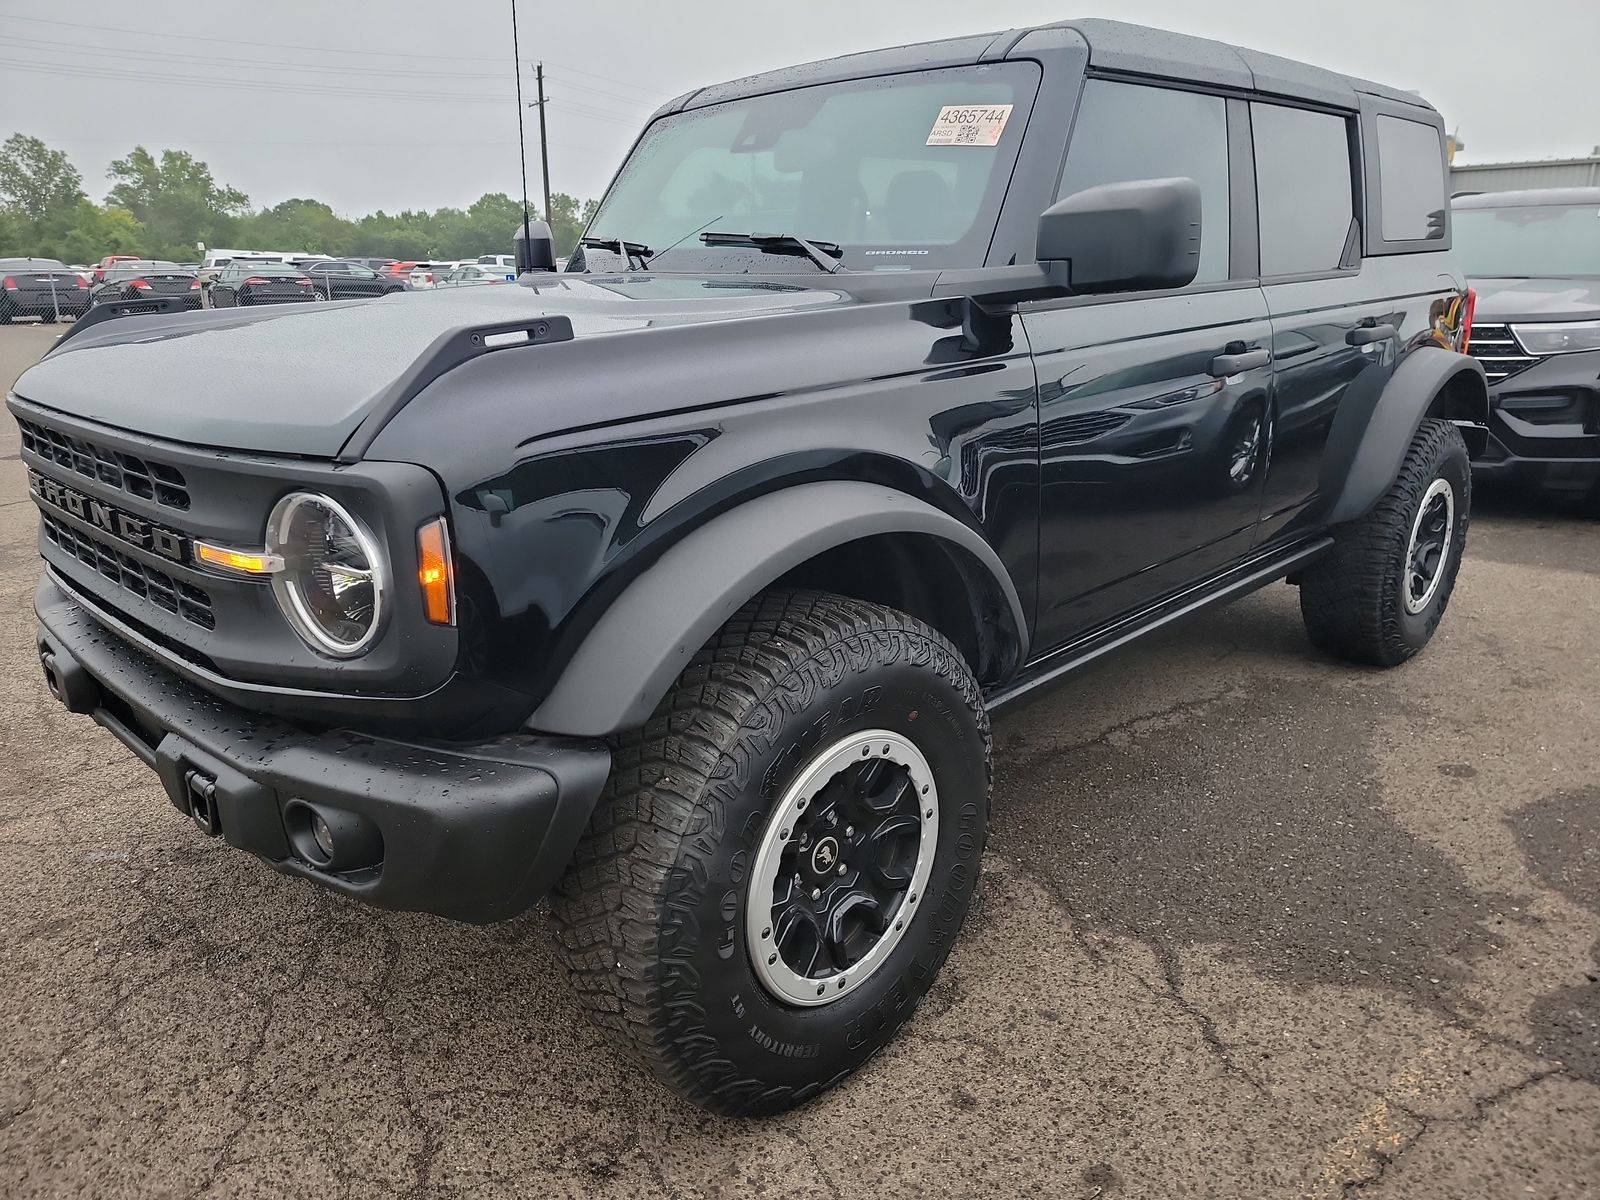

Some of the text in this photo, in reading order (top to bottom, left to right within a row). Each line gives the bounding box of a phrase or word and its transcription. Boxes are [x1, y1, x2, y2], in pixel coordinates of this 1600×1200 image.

[940, 109, 1006, 124] 4365744
[931, 129, 953, 137] ARSD
[28, 468, 187, 560] BRONCO
